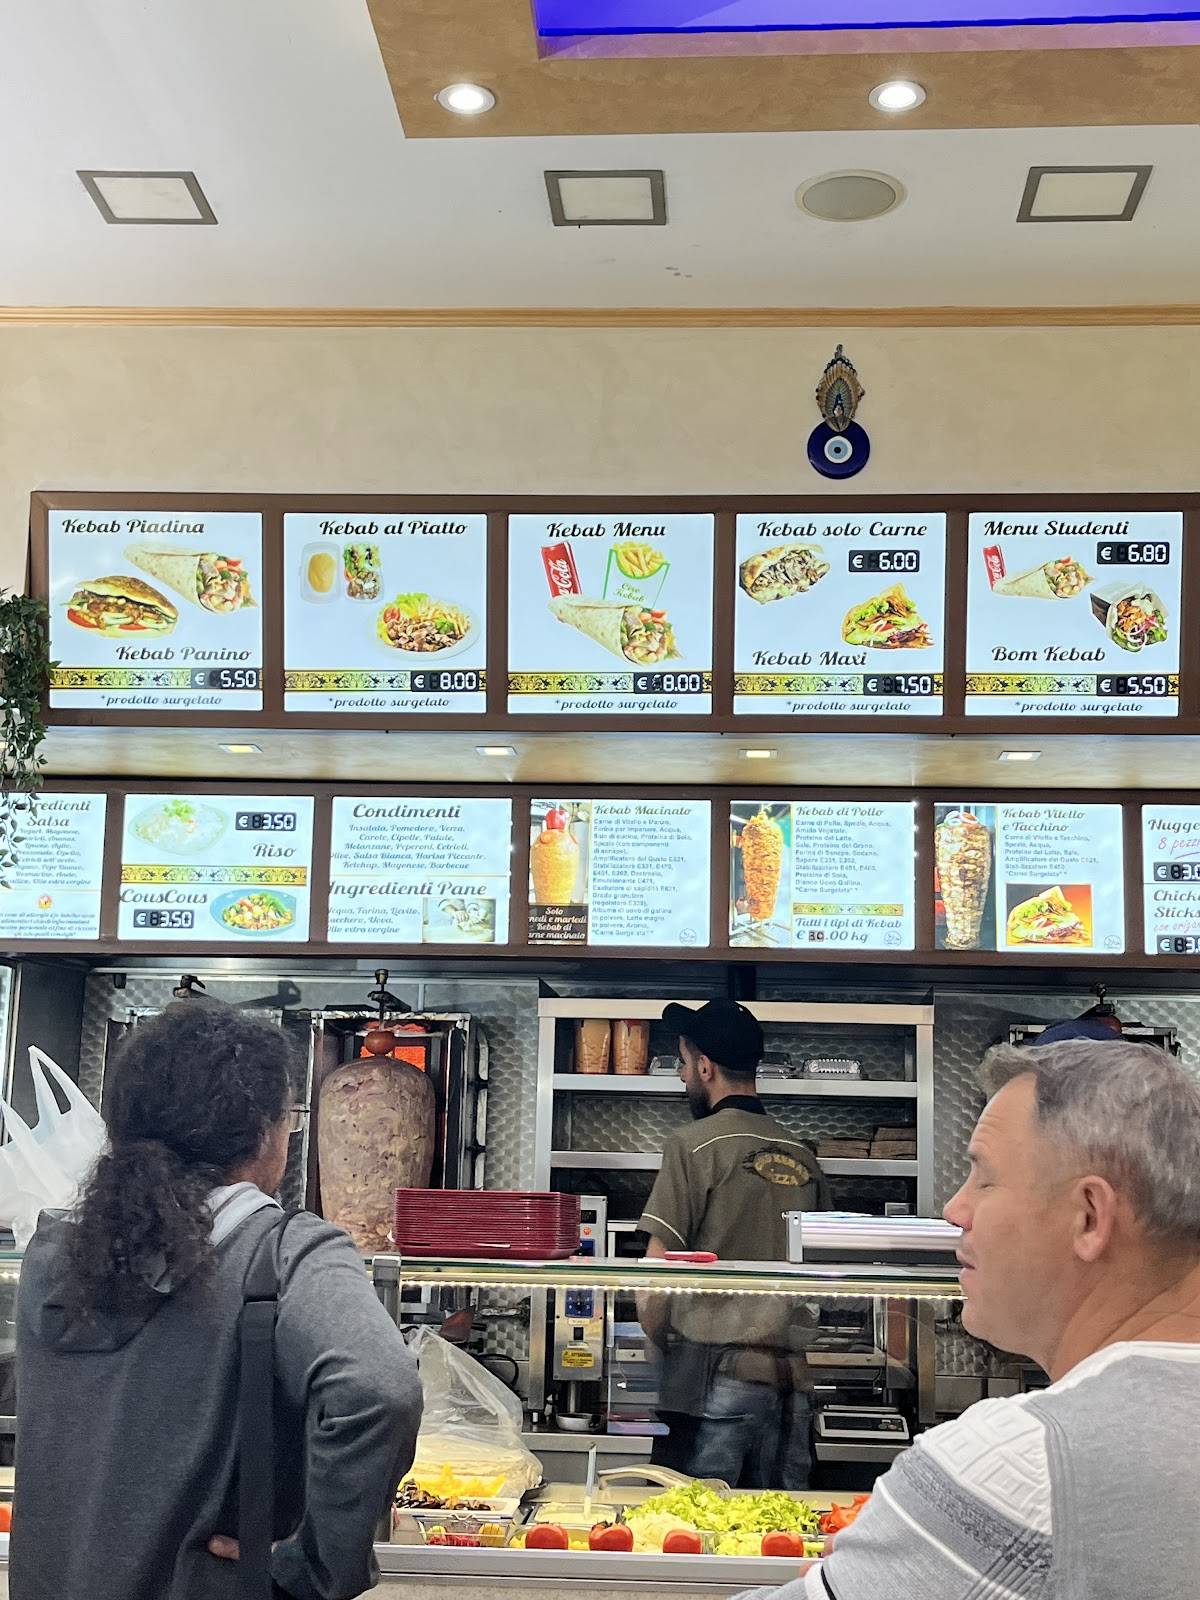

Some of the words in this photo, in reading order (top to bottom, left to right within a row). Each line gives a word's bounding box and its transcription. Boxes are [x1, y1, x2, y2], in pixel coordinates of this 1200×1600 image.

[62, 519, 120, 533] Kebab
[126, 519, 205, 534] Piadina
[320, 520, 378, 535] Kebab
[384, 521, 404, 535] al
[408, 520, 467, 535] Piatto
[547, 522, 605, 537] Kebab
[613, 522, 666, 537] Menu
[757, 521, 817, 537] Kebab
[823, 522, 861, 537] solo
[869, 521, 927, 537] Carne
[984, 520, 1038, 535] Menu
[1044, 520, 1130, 535] Studenti
[879, 552, 917, 569] 6.00
[1128, 544, 1167, 562] 6.80
[116, 646, 174, 660] Kebab
[180, 646, 252, 661] Panino
[753, 651, 812, 666] Kebab
[819, 651, 867, 666] Maxi
[992, 646, 1038, 661] Bom
[1044, 646, 1105, 661] Kebab
[220, 670, 257, 687] 5.50
[439, 672, 476, 689] 8.00
[662, 674, 700, 691] 8.00
[1127, 676, 1166, 694] 5.50
[163, 695, 223, 706] surgelato
[390, 698, 450, 709] surgelato
[617, 700, 677, 711] surgelato
[850, 702, 911, 713] surgelato
[1080, 702, 1143, 713] surgelato
[353, 803, 462, 818] Condimenti
[593, 805, 632, 815] Kebab
[635, 805, 692, 816] Macinato
[796, 807, 834, 817] Kebab
[836, 807, 849, 816] di
[851, 807, 885, 817] Pollo
[1002, 808, 1041, 819] Kebab
[1044, 808, 1085, 819] Vitello
[27, 816, 70, 827] Salsa
[1002, 823, 1010, 831] e
[1012, 821, 1069, 832] Tacchino
[1158, 836, 1168, 849] 8
[252, 843, 296, 858] Riso
[354, 852, 379, 860] Salsa
[120, 888, 208, 904] CousCous
[329, 881, 433, 899] Ingredienti
[437, 881, 487, 895] Pane
[545, 907, 564, 915] Solo
[536, 922, 562, 931] Kebab
[562, 923, 573, 931] di
[795, 918, 821, 927] Tutti
[830, 918, 850, 929] tipi
[851, 919, 863, 928] di
[865, 919, 902, 928] Kebab
[851, 931, 868, 943] kg
